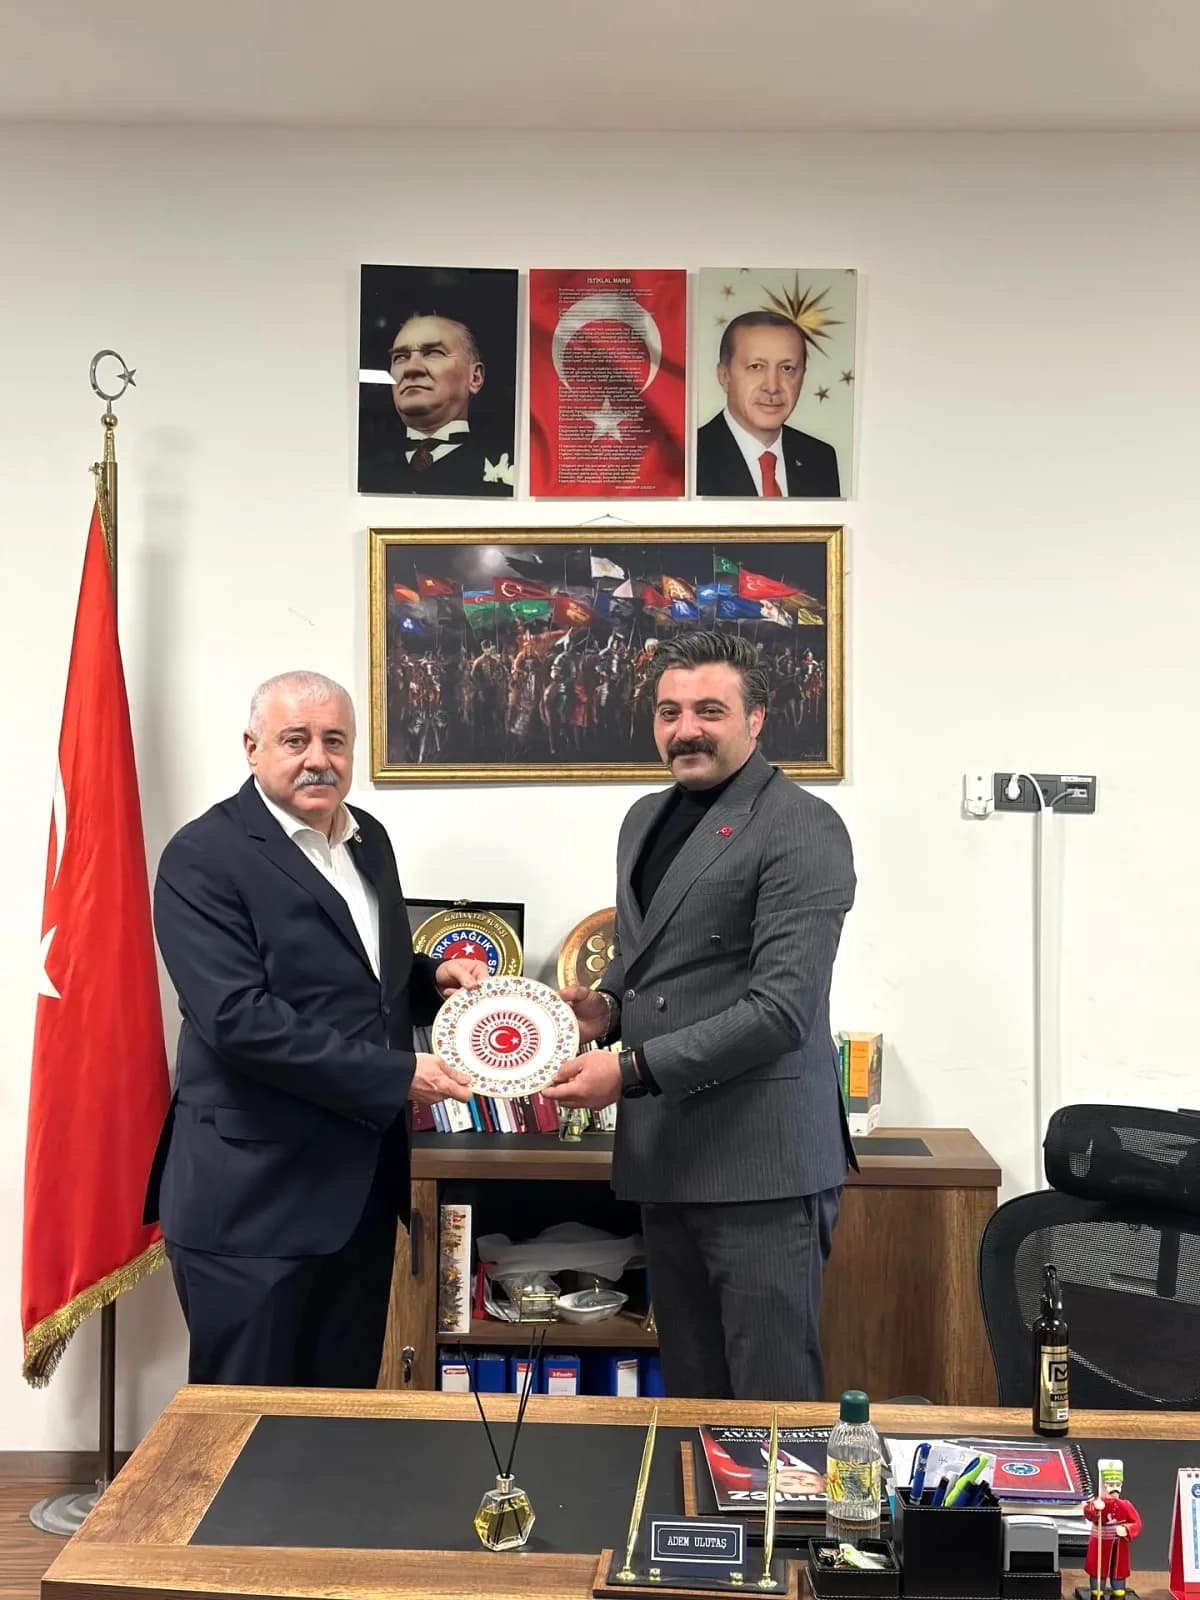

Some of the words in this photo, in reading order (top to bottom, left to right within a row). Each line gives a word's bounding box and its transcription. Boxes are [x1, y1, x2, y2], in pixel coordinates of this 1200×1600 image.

[432, 938, 451, 959] ÜRK
[451, 931, 493, 952] SAĞLIK
[667, 1535, 690, 1547] ADEM
[694, 1536, 727, 1549] ULUTAŞ
